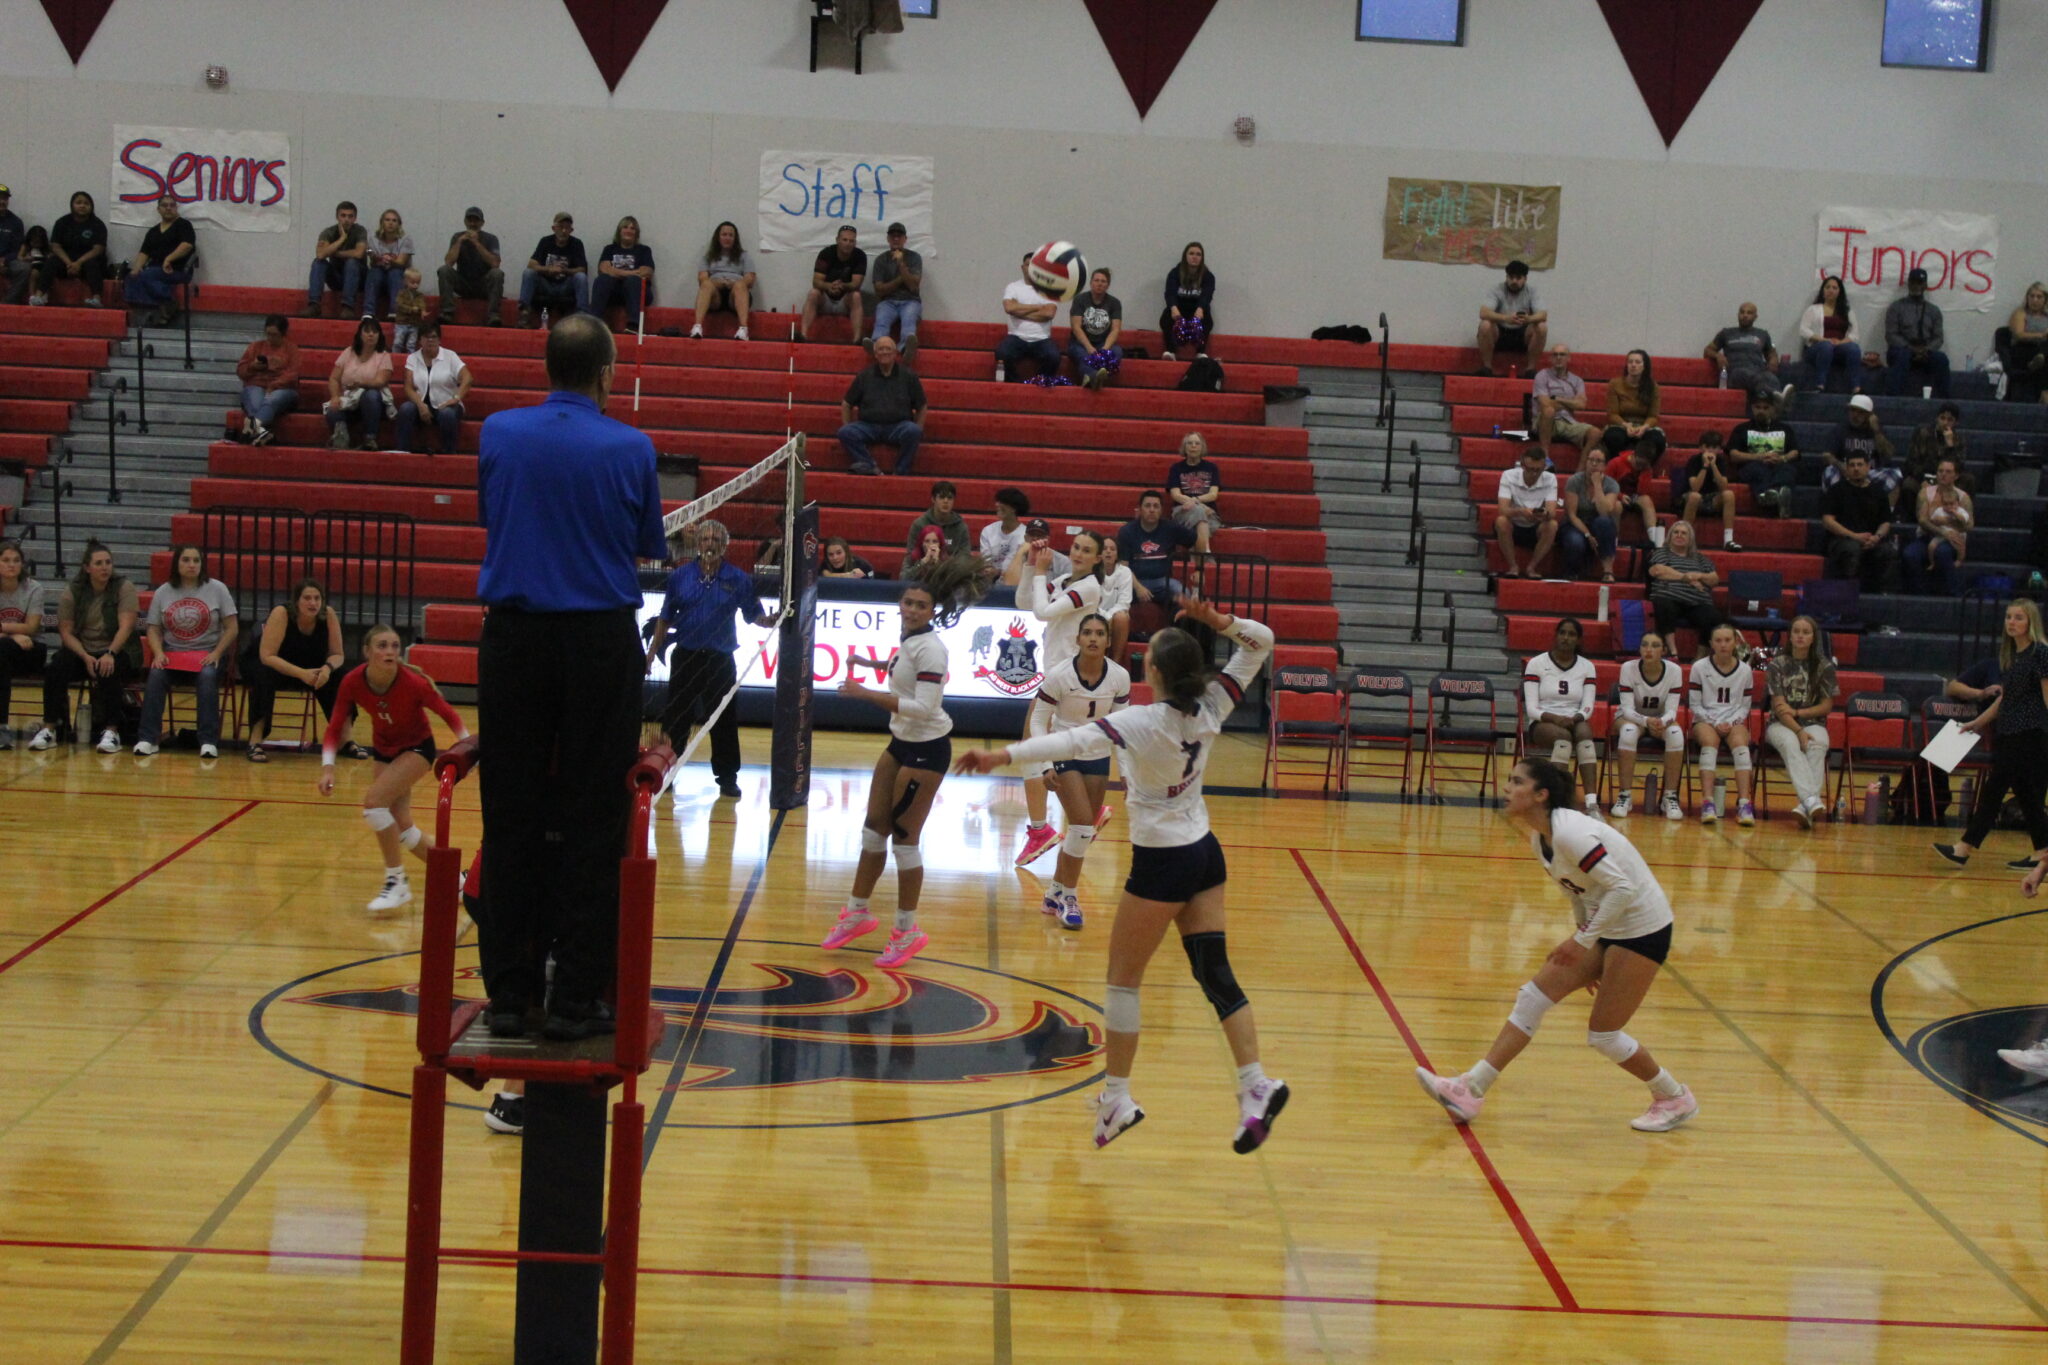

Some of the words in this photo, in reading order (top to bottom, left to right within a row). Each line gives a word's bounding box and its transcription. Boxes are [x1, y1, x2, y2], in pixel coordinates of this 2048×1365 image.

[119, 139, 286, 207] Seniors
[779, 162, 894, 221] Staff
[1400, 184, 1471, 236] Fight
[1820, 226, 1994, 294] Juniors
[853, 610, 886, 630] OF
[995, 679, 1012, 692] WEST
[1010, 684, 1030, 694] BLACK
[1028, 674, 1043, 688] HILLS
[1281, 672, 1328, 687] WOLVES
[1357, 674, 1404, 690] WOLVES
[1439, 678, 1486, 694] WOLVES
[1558, 680, 1569, 695] 9
[1641, 696, 1660, 709] 12
[1716, 687, 1731, 703] 11
[1086, 700, 1097, 719] 1
[1855, 698, 1902, 713] WOLVES
[377, 712, 393, 725] 4
[1181, 739, 1202, 780] 7
